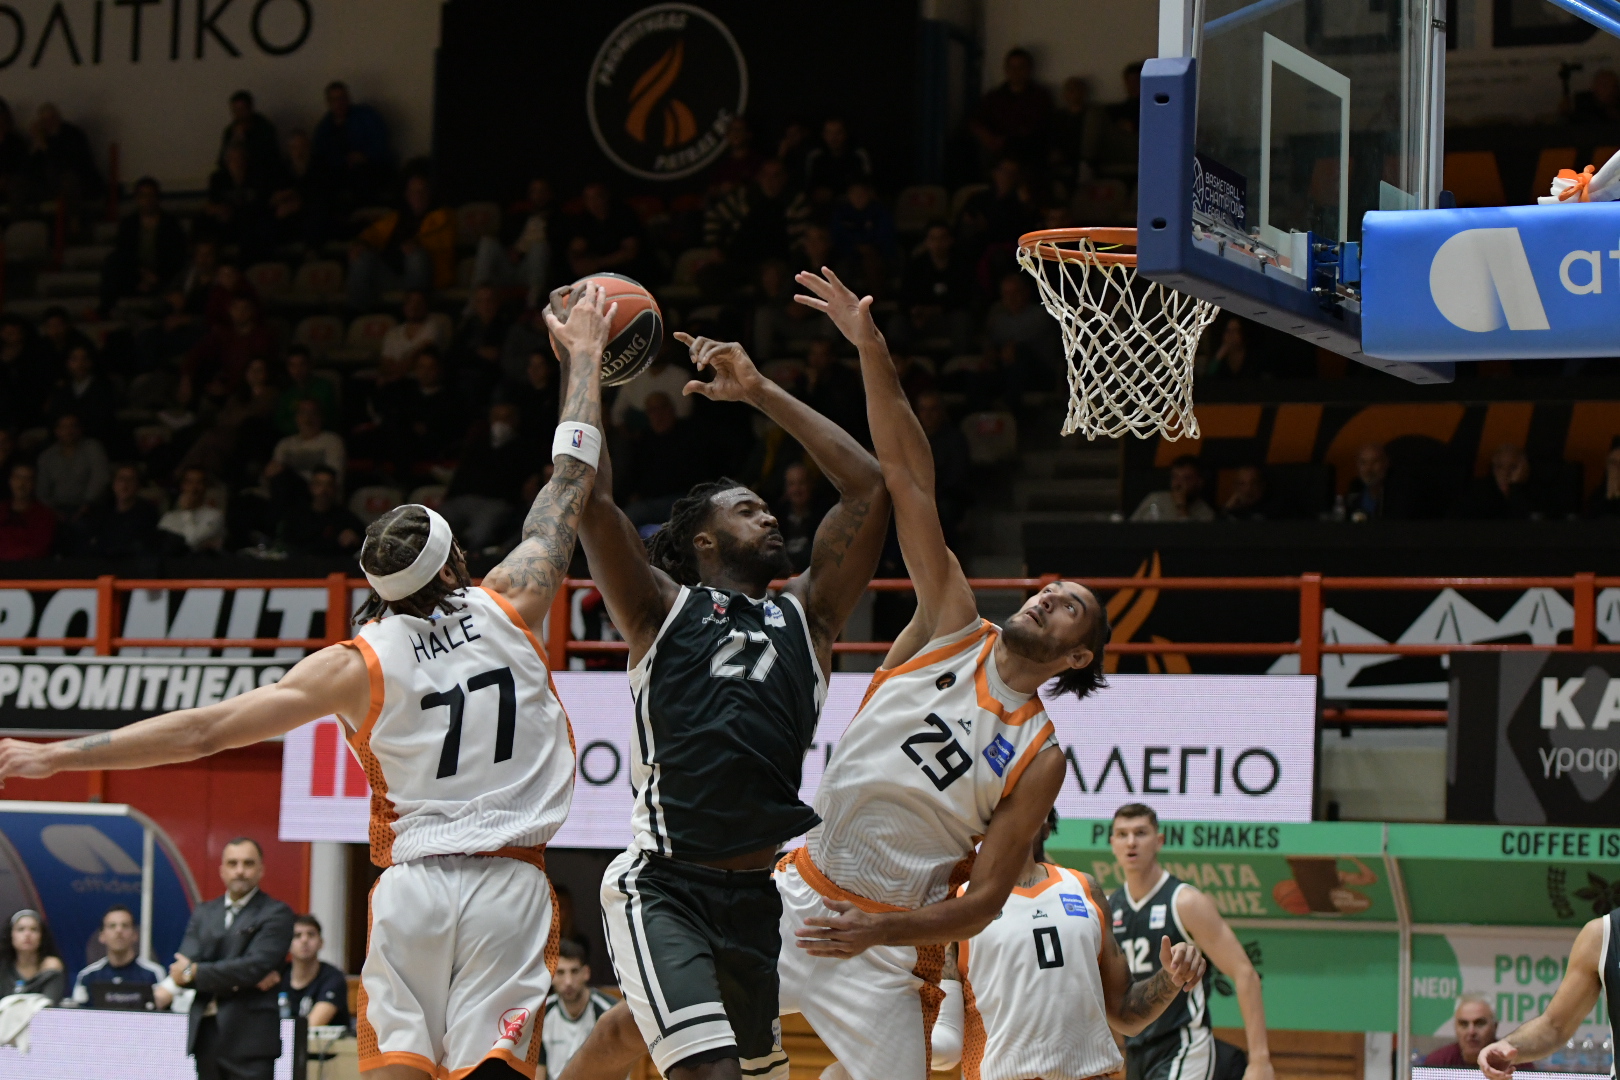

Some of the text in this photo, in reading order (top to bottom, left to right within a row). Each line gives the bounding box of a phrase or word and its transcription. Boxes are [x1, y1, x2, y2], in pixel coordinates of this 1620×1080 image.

[1204, 186, 1245, 219] CHAMPIONS
[1205, 171, 1241, 201] BASKETBALL
[408, 614, 482, 664] HALE
[709, 628, 779, 682] 27
[420, 666, 517, 780] 77
[900, 712, 974, 792] 29
[1539, 746, 1620, 779] γραφ
[1192, 825, 1280, 849] SHAKES
[1501, 830, 1591, 857] COFFEE
[1032, 925, 1065, 970] 0
[1120, 936, 1154, 974] 12
